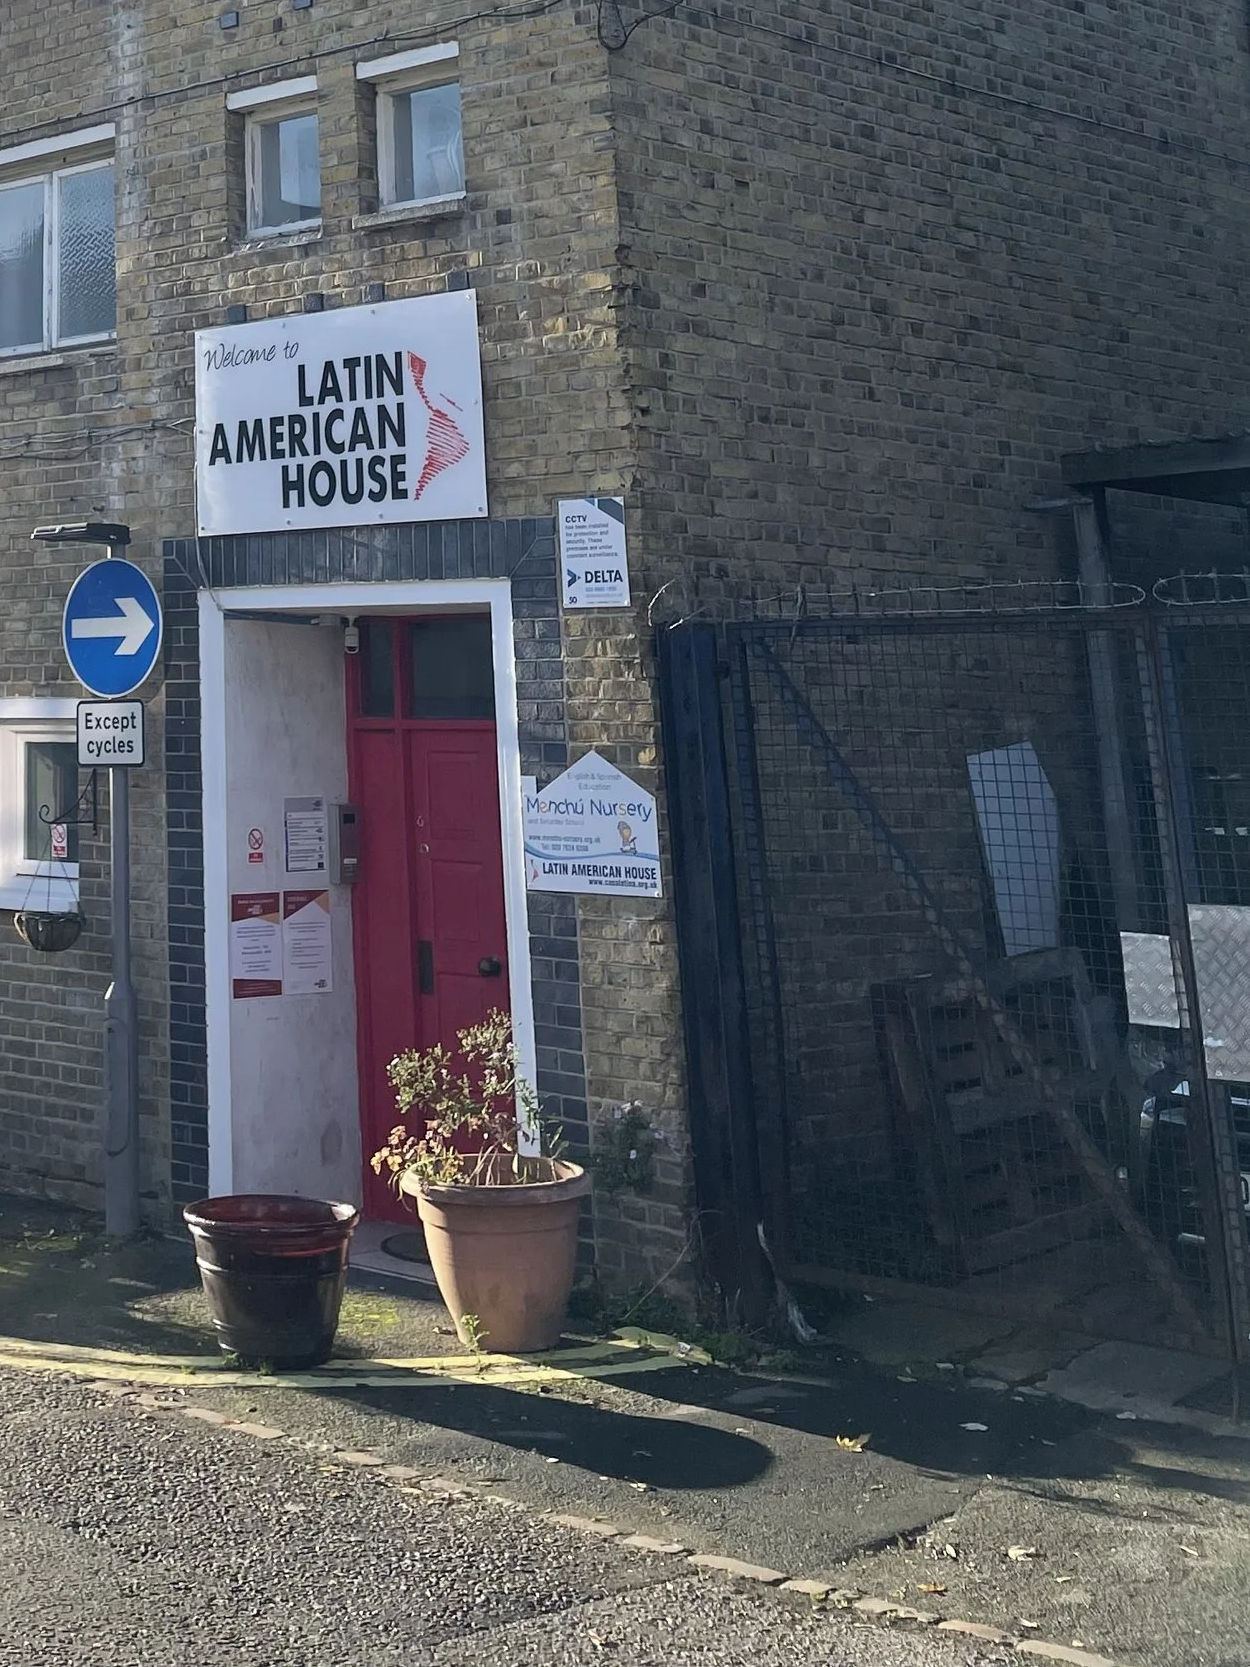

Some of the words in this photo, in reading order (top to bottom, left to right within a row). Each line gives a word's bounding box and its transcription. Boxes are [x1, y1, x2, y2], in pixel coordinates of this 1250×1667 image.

[203, 343, 277, 371] Welcome
[283, 341, 299, 359] to
[298, 351, 404, 407] LATIN
[209, 403, 406, 466] AMERICAN
[281, 454, 408, 509] HOUSE
[565, 515, 587, 523] CCTV
[584, 569, 623, 584] DELTA
[84, 712, 137, 733] Except
[86, 737, 134, 757] cycles
[526, 797, 584, 816] Menchú
[590, 799, 652, 822] Nursery
[542, 862, 568, 875] LATIN
[571, 864, 622, 878] AMERICAN
[624, 867, 656, 880] HOUSE
